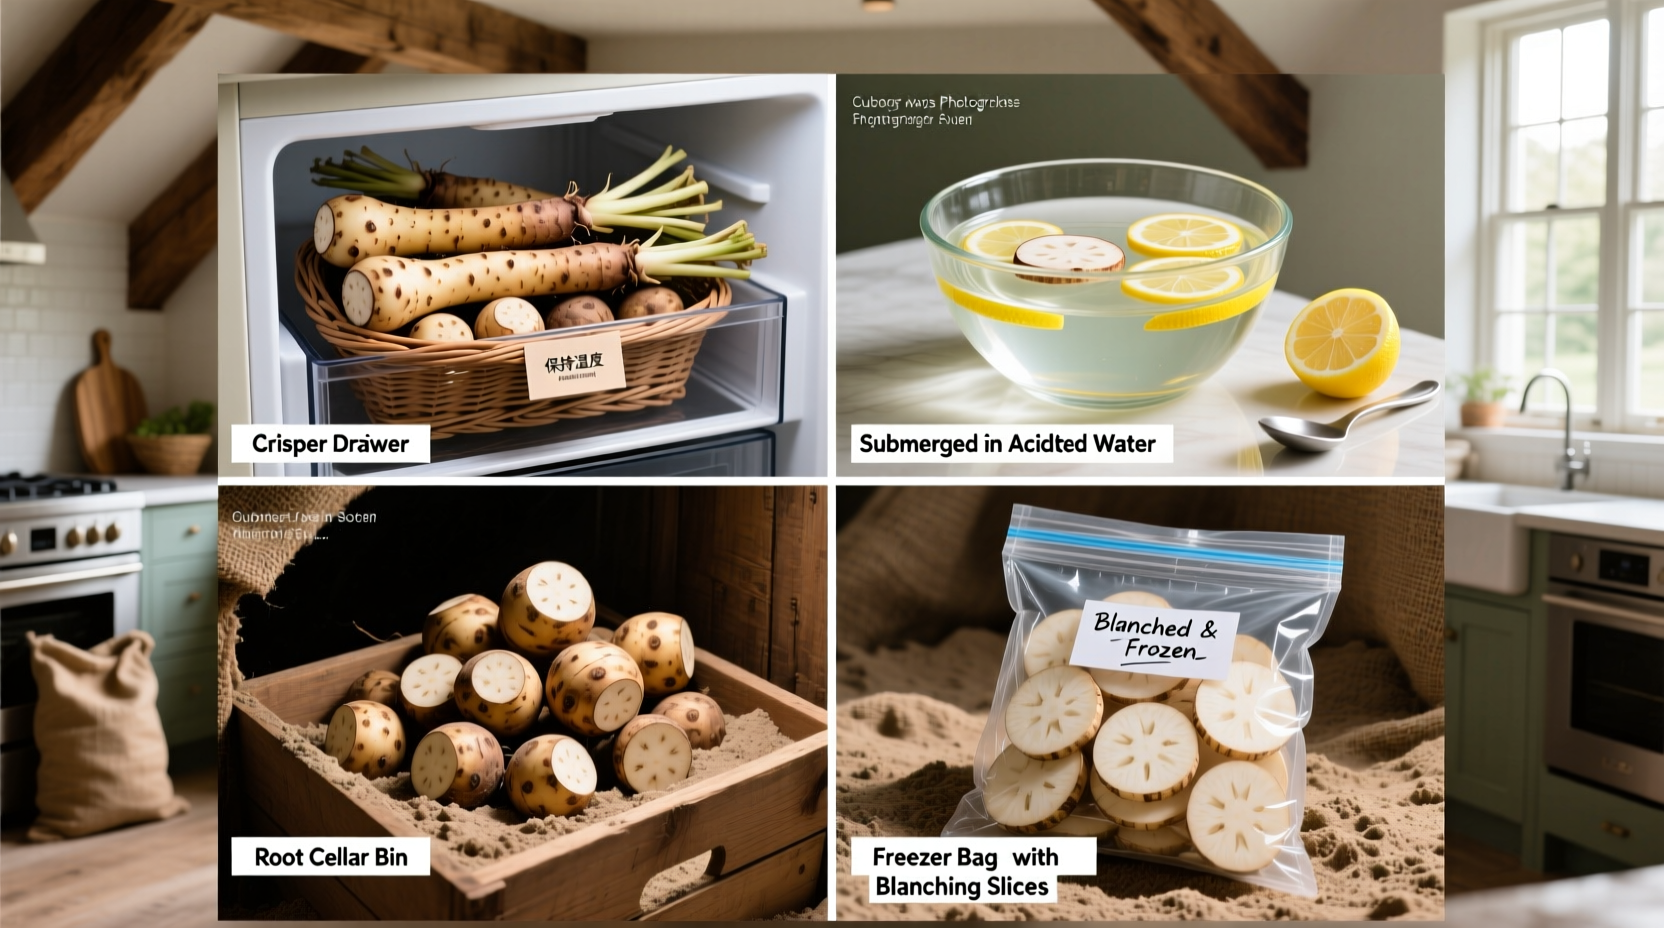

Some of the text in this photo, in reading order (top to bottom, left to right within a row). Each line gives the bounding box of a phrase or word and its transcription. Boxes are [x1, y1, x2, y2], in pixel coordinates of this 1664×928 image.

[545, 351, 604, 374] 保持温度
[1094, 610, 1218, 639] Blanched &
